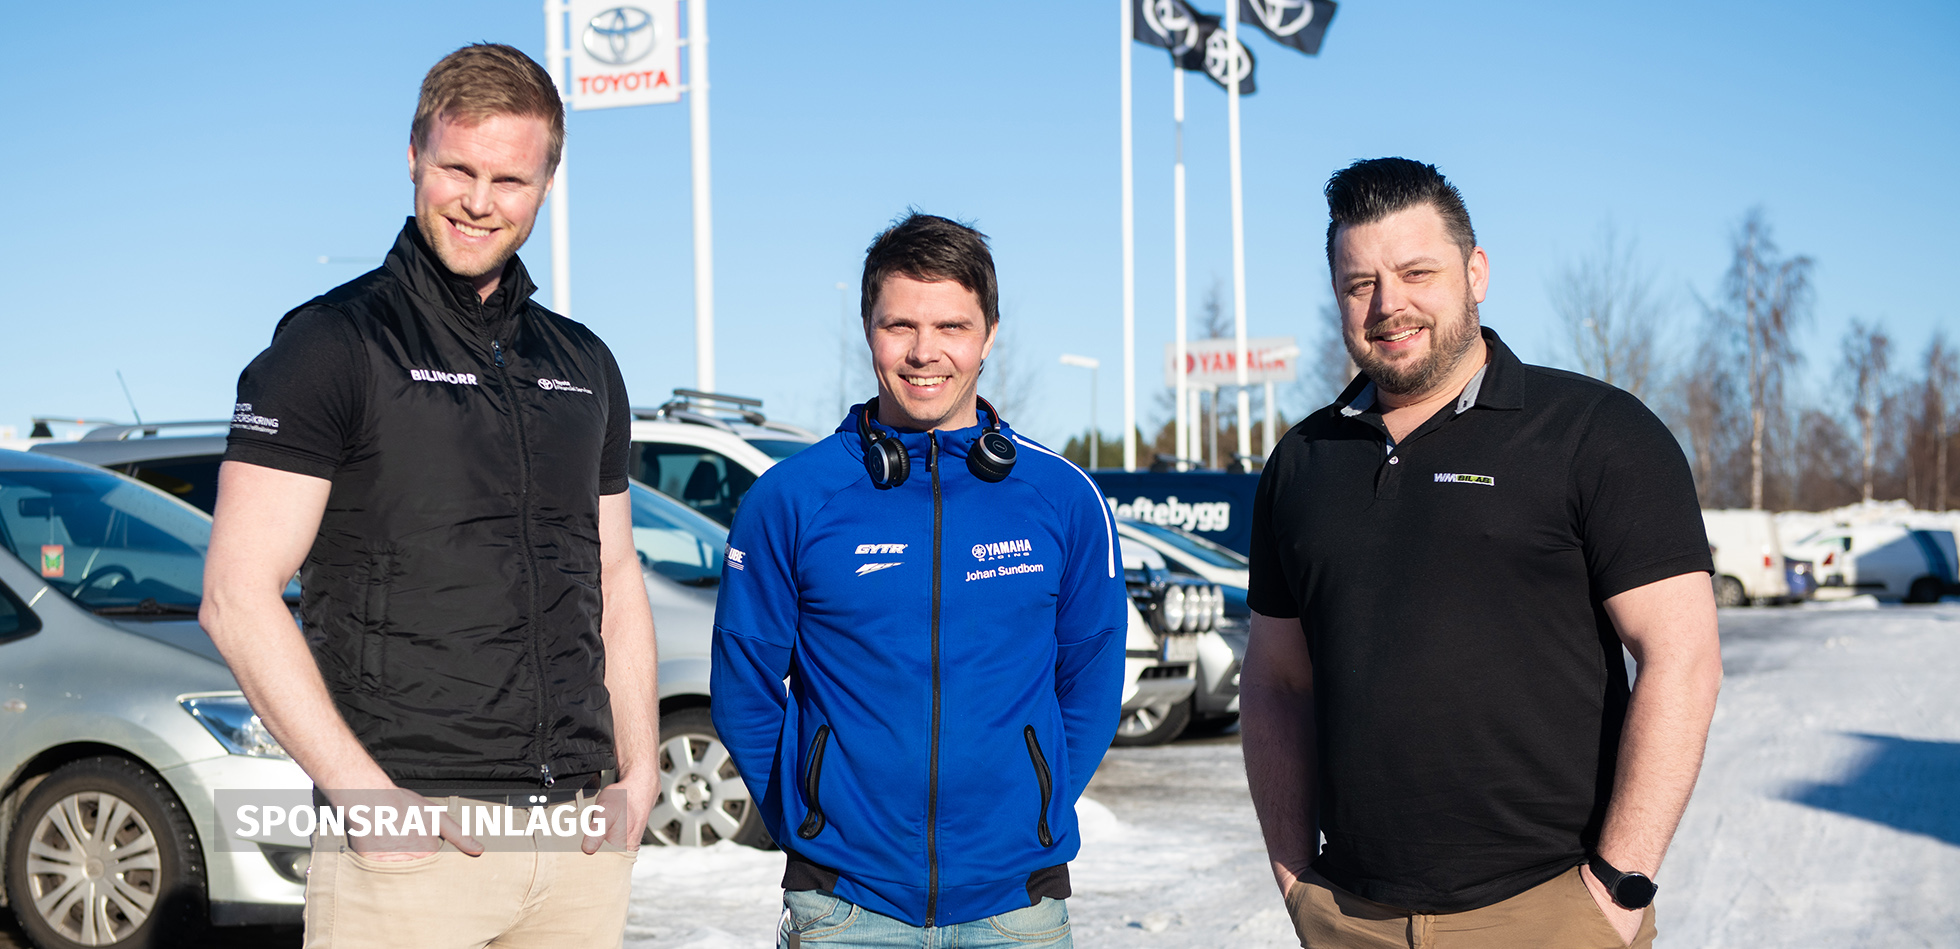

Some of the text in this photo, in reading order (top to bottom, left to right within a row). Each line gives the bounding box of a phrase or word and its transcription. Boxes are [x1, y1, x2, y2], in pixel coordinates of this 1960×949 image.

[578, 70, 670, 95] TOYOTA
[410, 369, 478, 385] BILINORR
[1433, 473, 1455, 482] WM
[1107, 496, 1230, 531] leftebygg
[854, 543, 904, 554] GYTR
[985, 539, 1032, 556] YAMAHA
[965, 563, 1044, 582] Johan Sundbom
